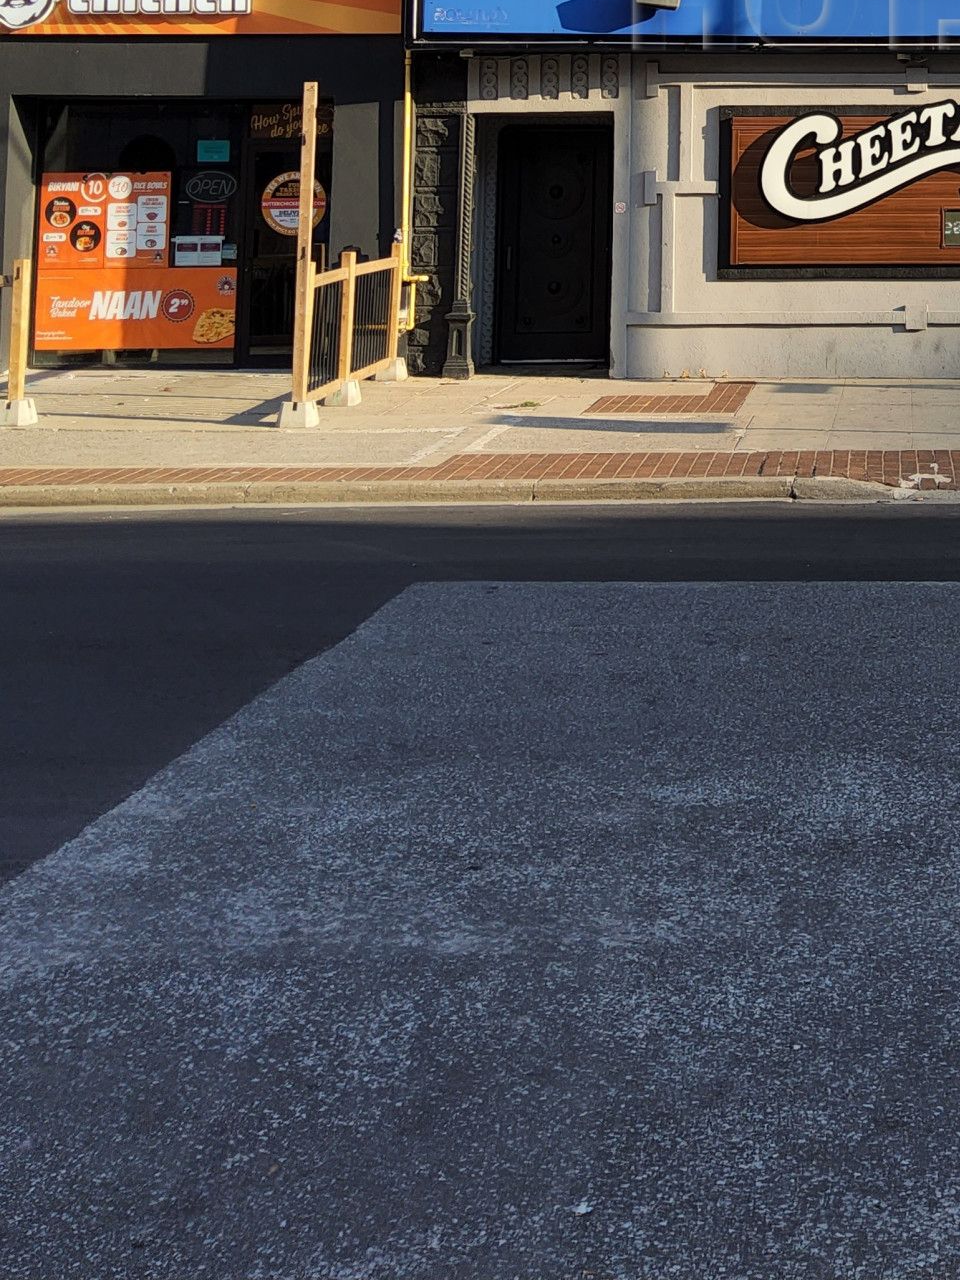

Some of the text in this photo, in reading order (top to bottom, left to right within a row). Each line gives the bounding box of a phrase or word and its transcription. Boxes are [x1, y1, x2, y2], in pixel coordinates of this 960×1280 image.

[88, 180, 103, 195] 10
[188, 180, 232, 195] OPEN
[50, 296, 91, 309] Tandoor
[89, 290, 162, 321] NAAN
